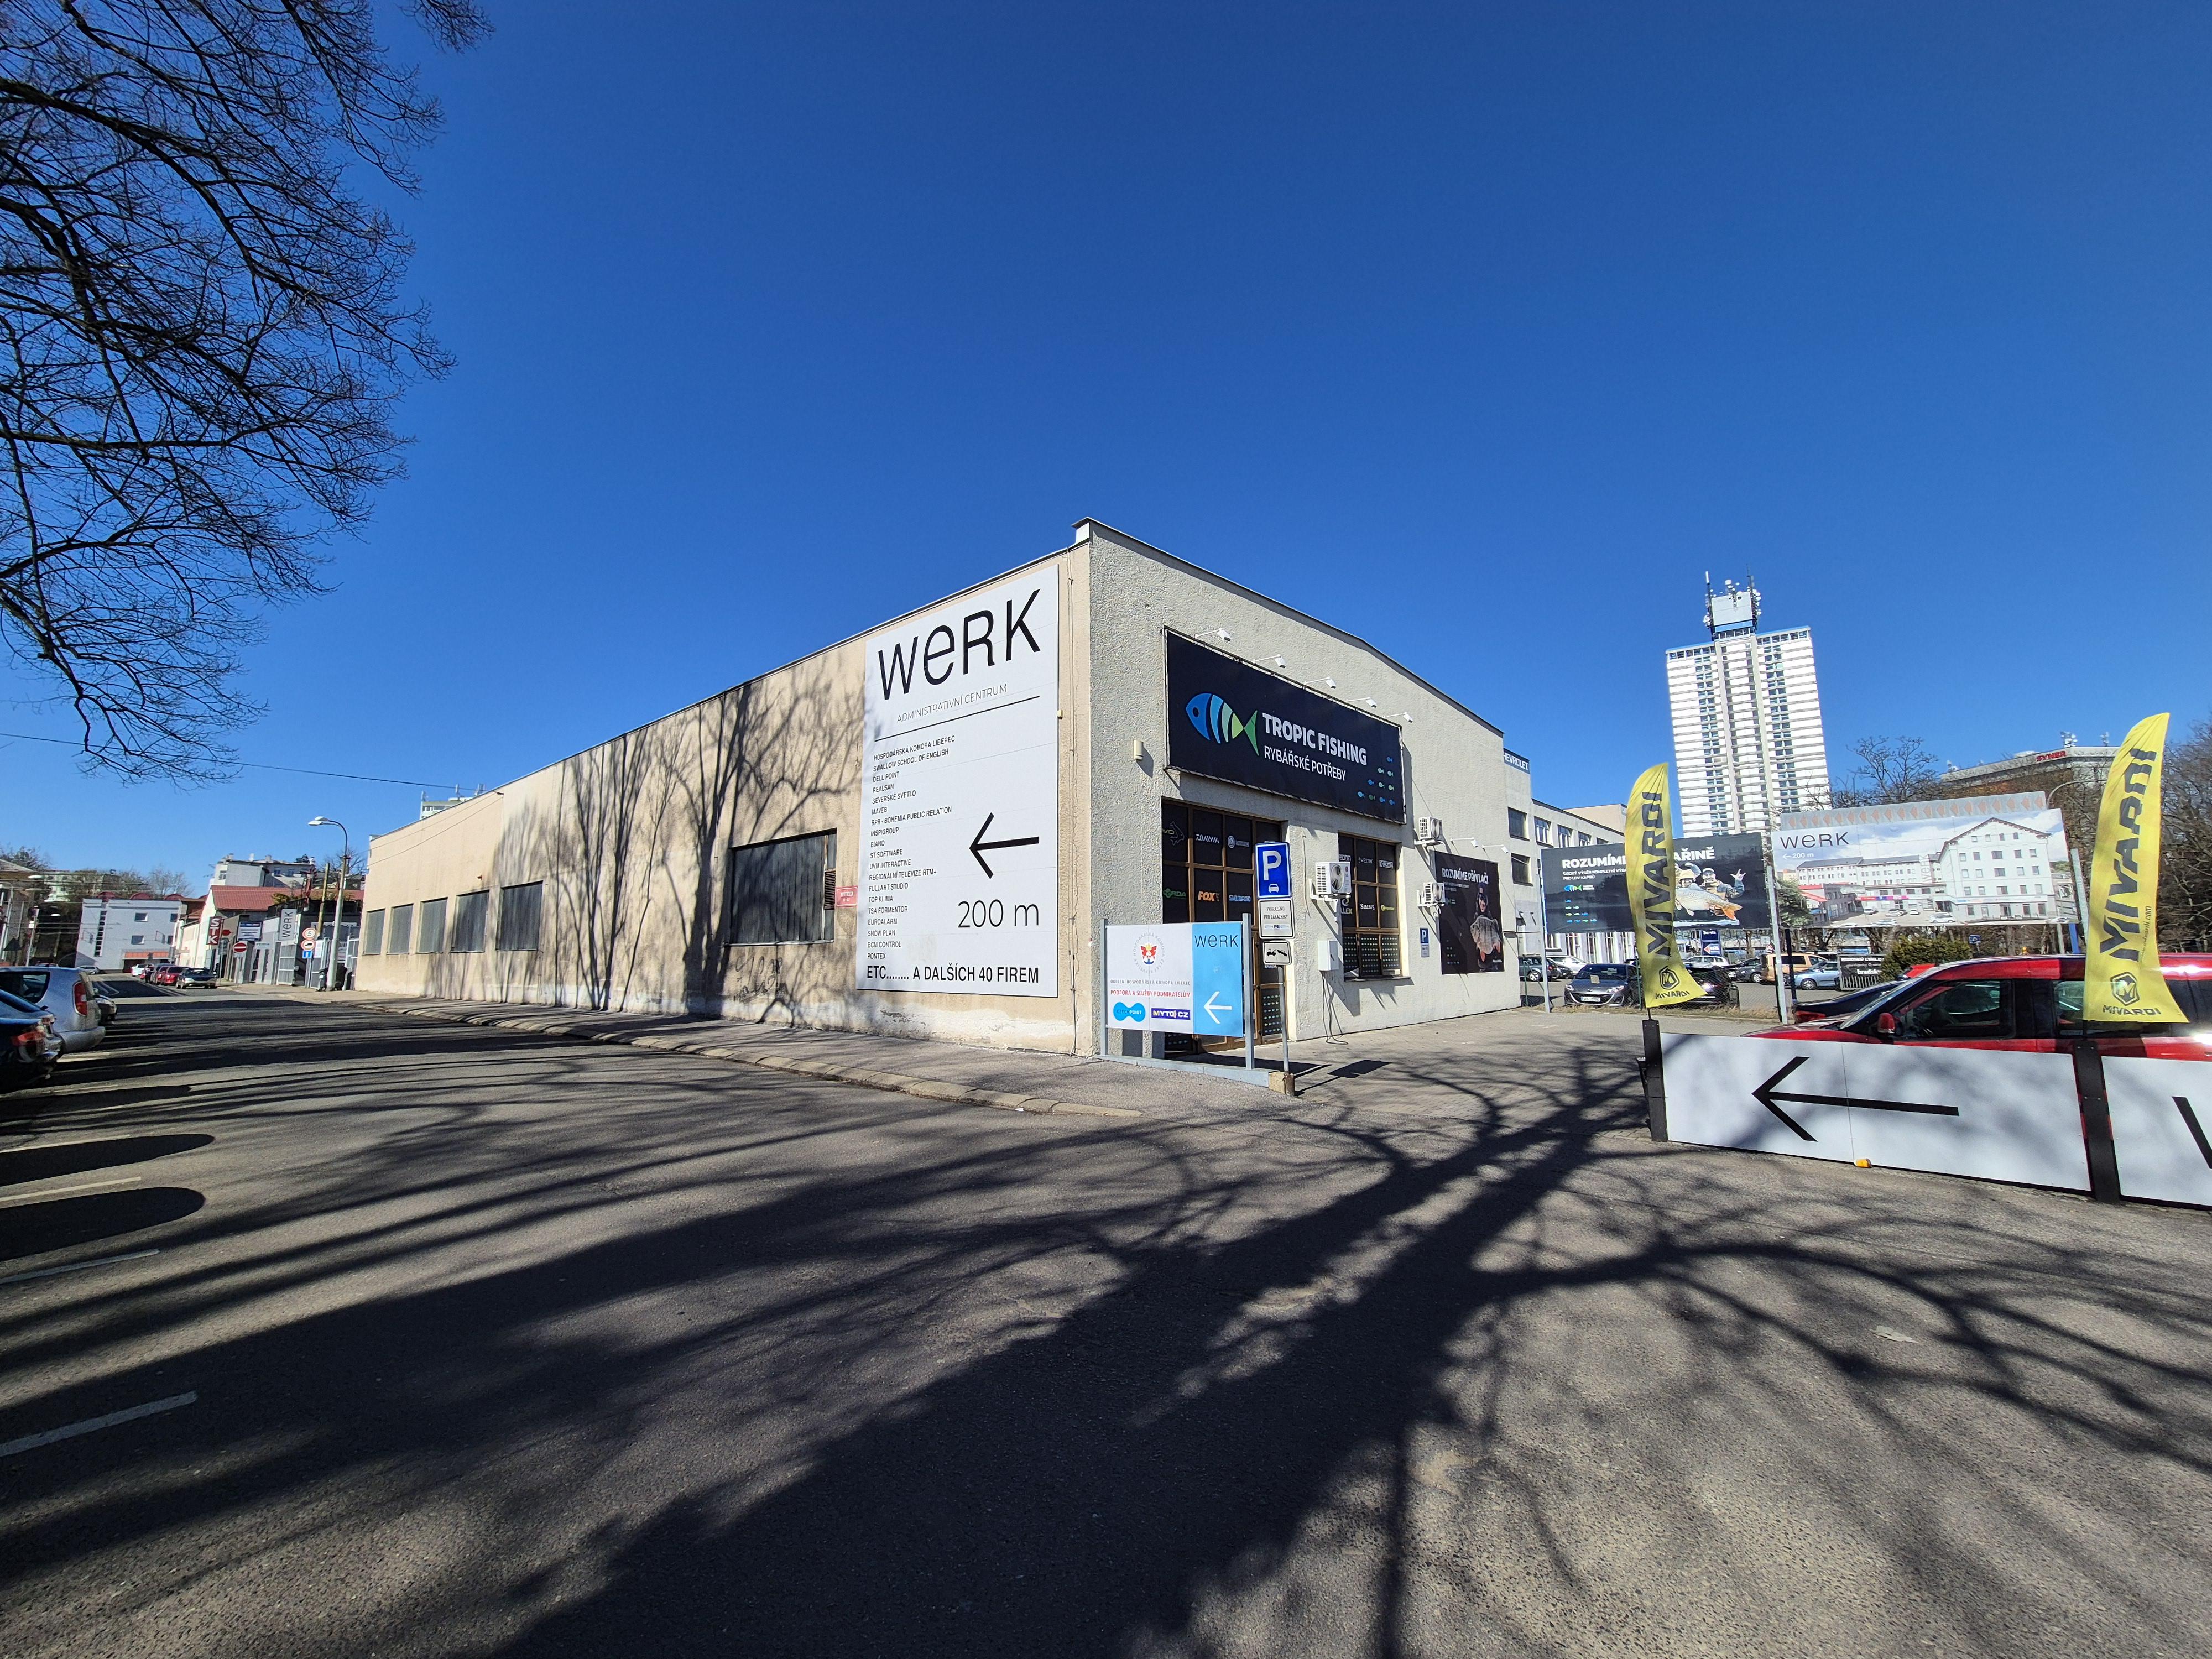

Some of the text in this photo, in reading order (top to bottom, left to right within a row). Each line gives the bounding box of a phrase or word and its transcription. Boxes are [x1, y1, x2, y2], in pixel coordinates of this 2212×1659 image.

[896, 684, 1008, 723] ADMINISTRATIVNÍ CENTRUM
[910, 741, 931, 752] KOMORA
[932, 735, 955, 747] LIBEREC
[1262, 712, 1367, 765] TROPIC FISHING
[873, 761, 896, 772] SWALLOW
[897, 757, 917, 766] SCHOOL
[926, 748, 949, 759] ENGLISH
[1264, 745, 1346, 781] RYBÁŘSKÉ POTŘEBY
[1503, 752, 1528, 770] HEVROLET
[885, 771, 899, 780] POINT
[873, 784, 894, 793] REALSAN
[872, 789, 916, 804] SEVERSKÉ SVĚTLO
[871, 817, 880, 826] BPR
[884, 815, 906, 824] BOHEMIA
[907, 811, 925, 821] PUBLIC
[926, 806, 952, 817] RELATION
[872, 806, 888, 815] MAVEB
[870, 827, 899, 837] INSPIGROUP
[1196, 834, 1220, 844] DAIWA
[870, 839, 885, 848] BIANO
[877, 849, 902, 858] SOFTWARE
[1673, 846, 1715, 861] AŘINĚ
[2100, 748, 2157, 962] MIVARDI
[880, 859, 911, 868] INTERACTIVE
[1262, 850, 1282, 881] P
[869, 871, 898, 880] REGIONÁLNÍ
[1442, 867, 1468, 881] ROZUMÍME
[1642, 791, 1672, 957] MIVARDI
[1198, 891, 1216, 901] FOX
[958, 899, 1039, 928] 200 m
[207, 918, 220, 944] STK
[1422, 930, 1427, 942] P
[913, 966, 920, 980] A
[924, 963, 975, 982] DALŠÍCH
[979, 967, 993, 982] 40
[997, 967, 1039, 983] FIREM
[1655, 990, 1691, 1000] MIVARDI
[2102, 1004, 2162, 1015] MIVARDI
